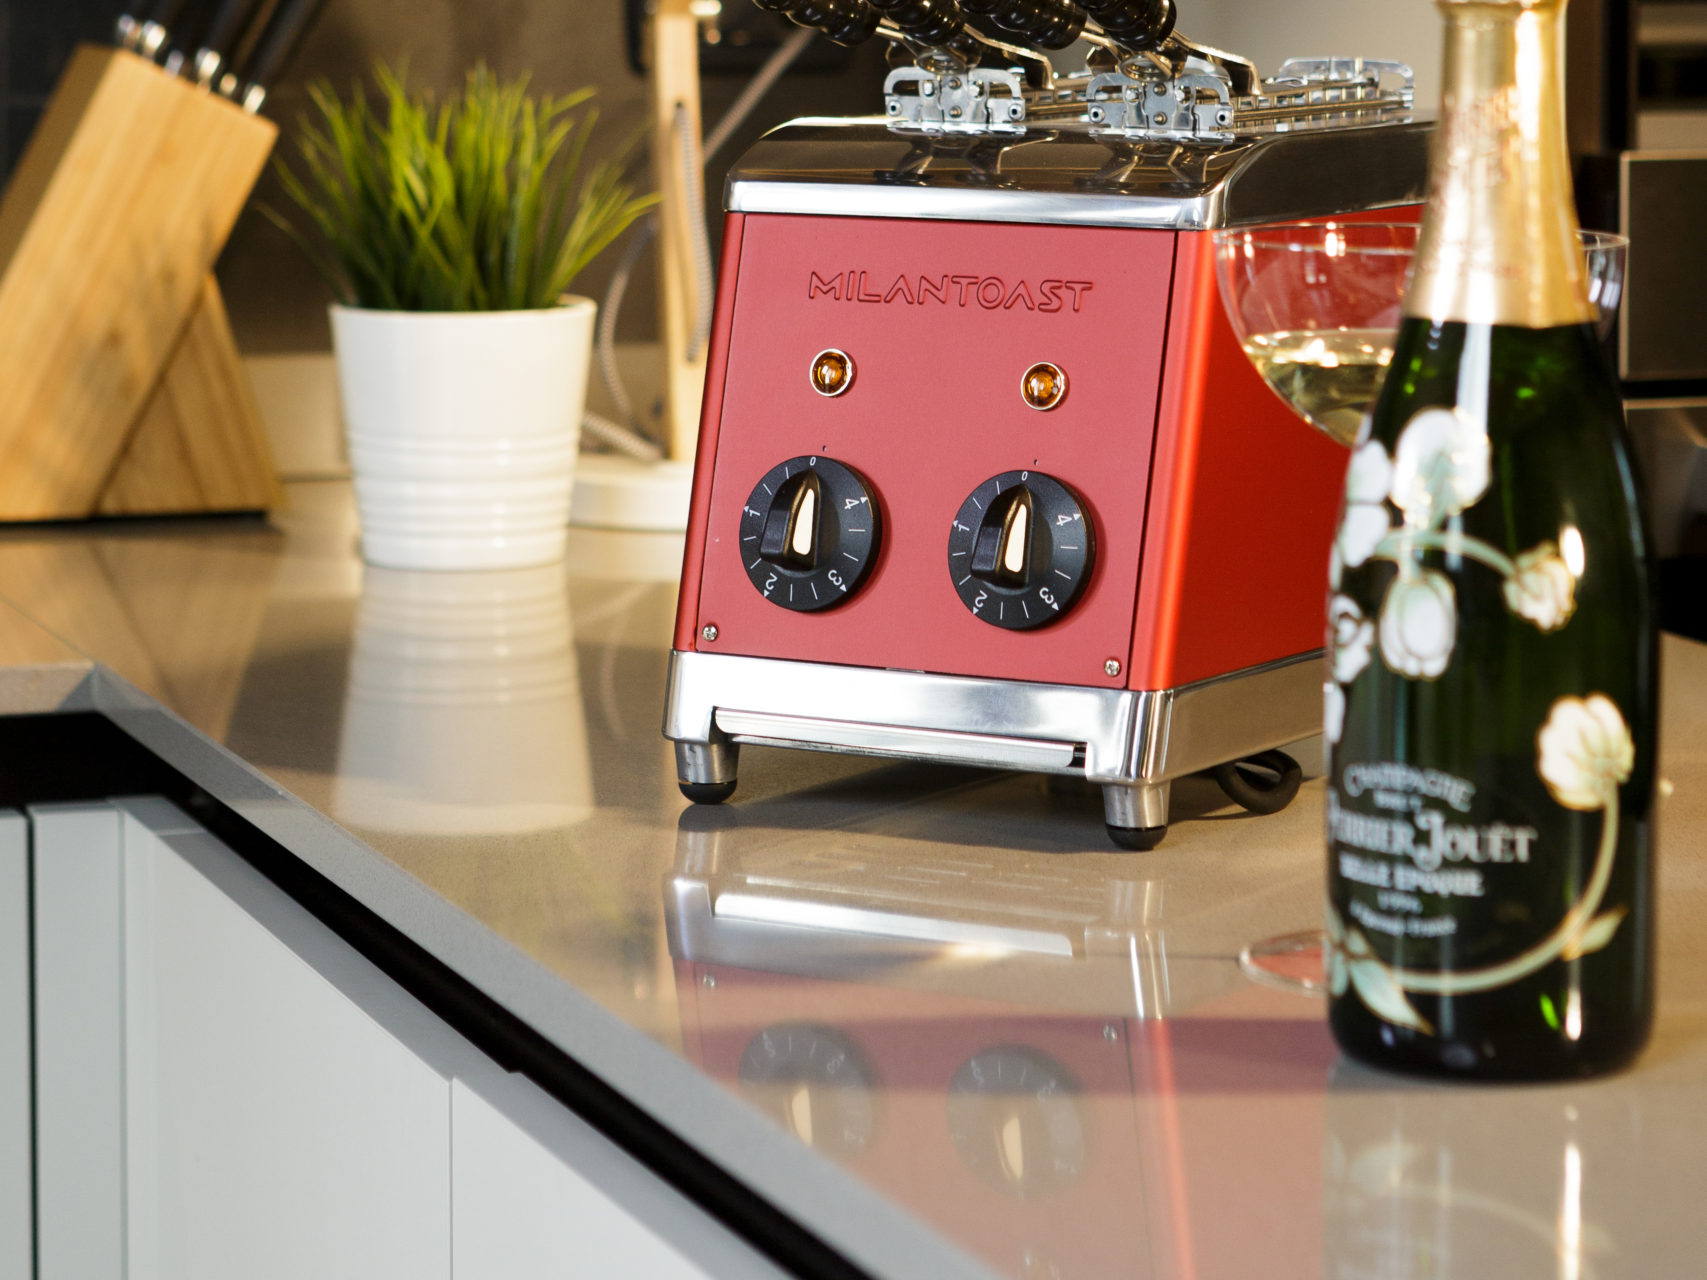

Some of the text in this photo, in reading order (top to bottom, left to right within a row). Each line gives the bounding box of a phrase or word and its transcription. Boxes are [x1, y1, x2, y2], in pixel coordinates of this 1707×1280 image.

[808, 270, 1094, 313] MILANTOAST
[809, 456, 817, 466] 0
[1021, 471, 1029, 481] 0
[844, 498, 860, 510] 4
[749, 508, 761, 517] 1
[1056, 514, 1073, 527] 4
[957, 523, 970, 532] 1
[765, 572, 778, 590] 2
[827, 569, 843, 586] 3
[974, 589, 988, 608] 2
[1039, 587, 1055, 605] 3
